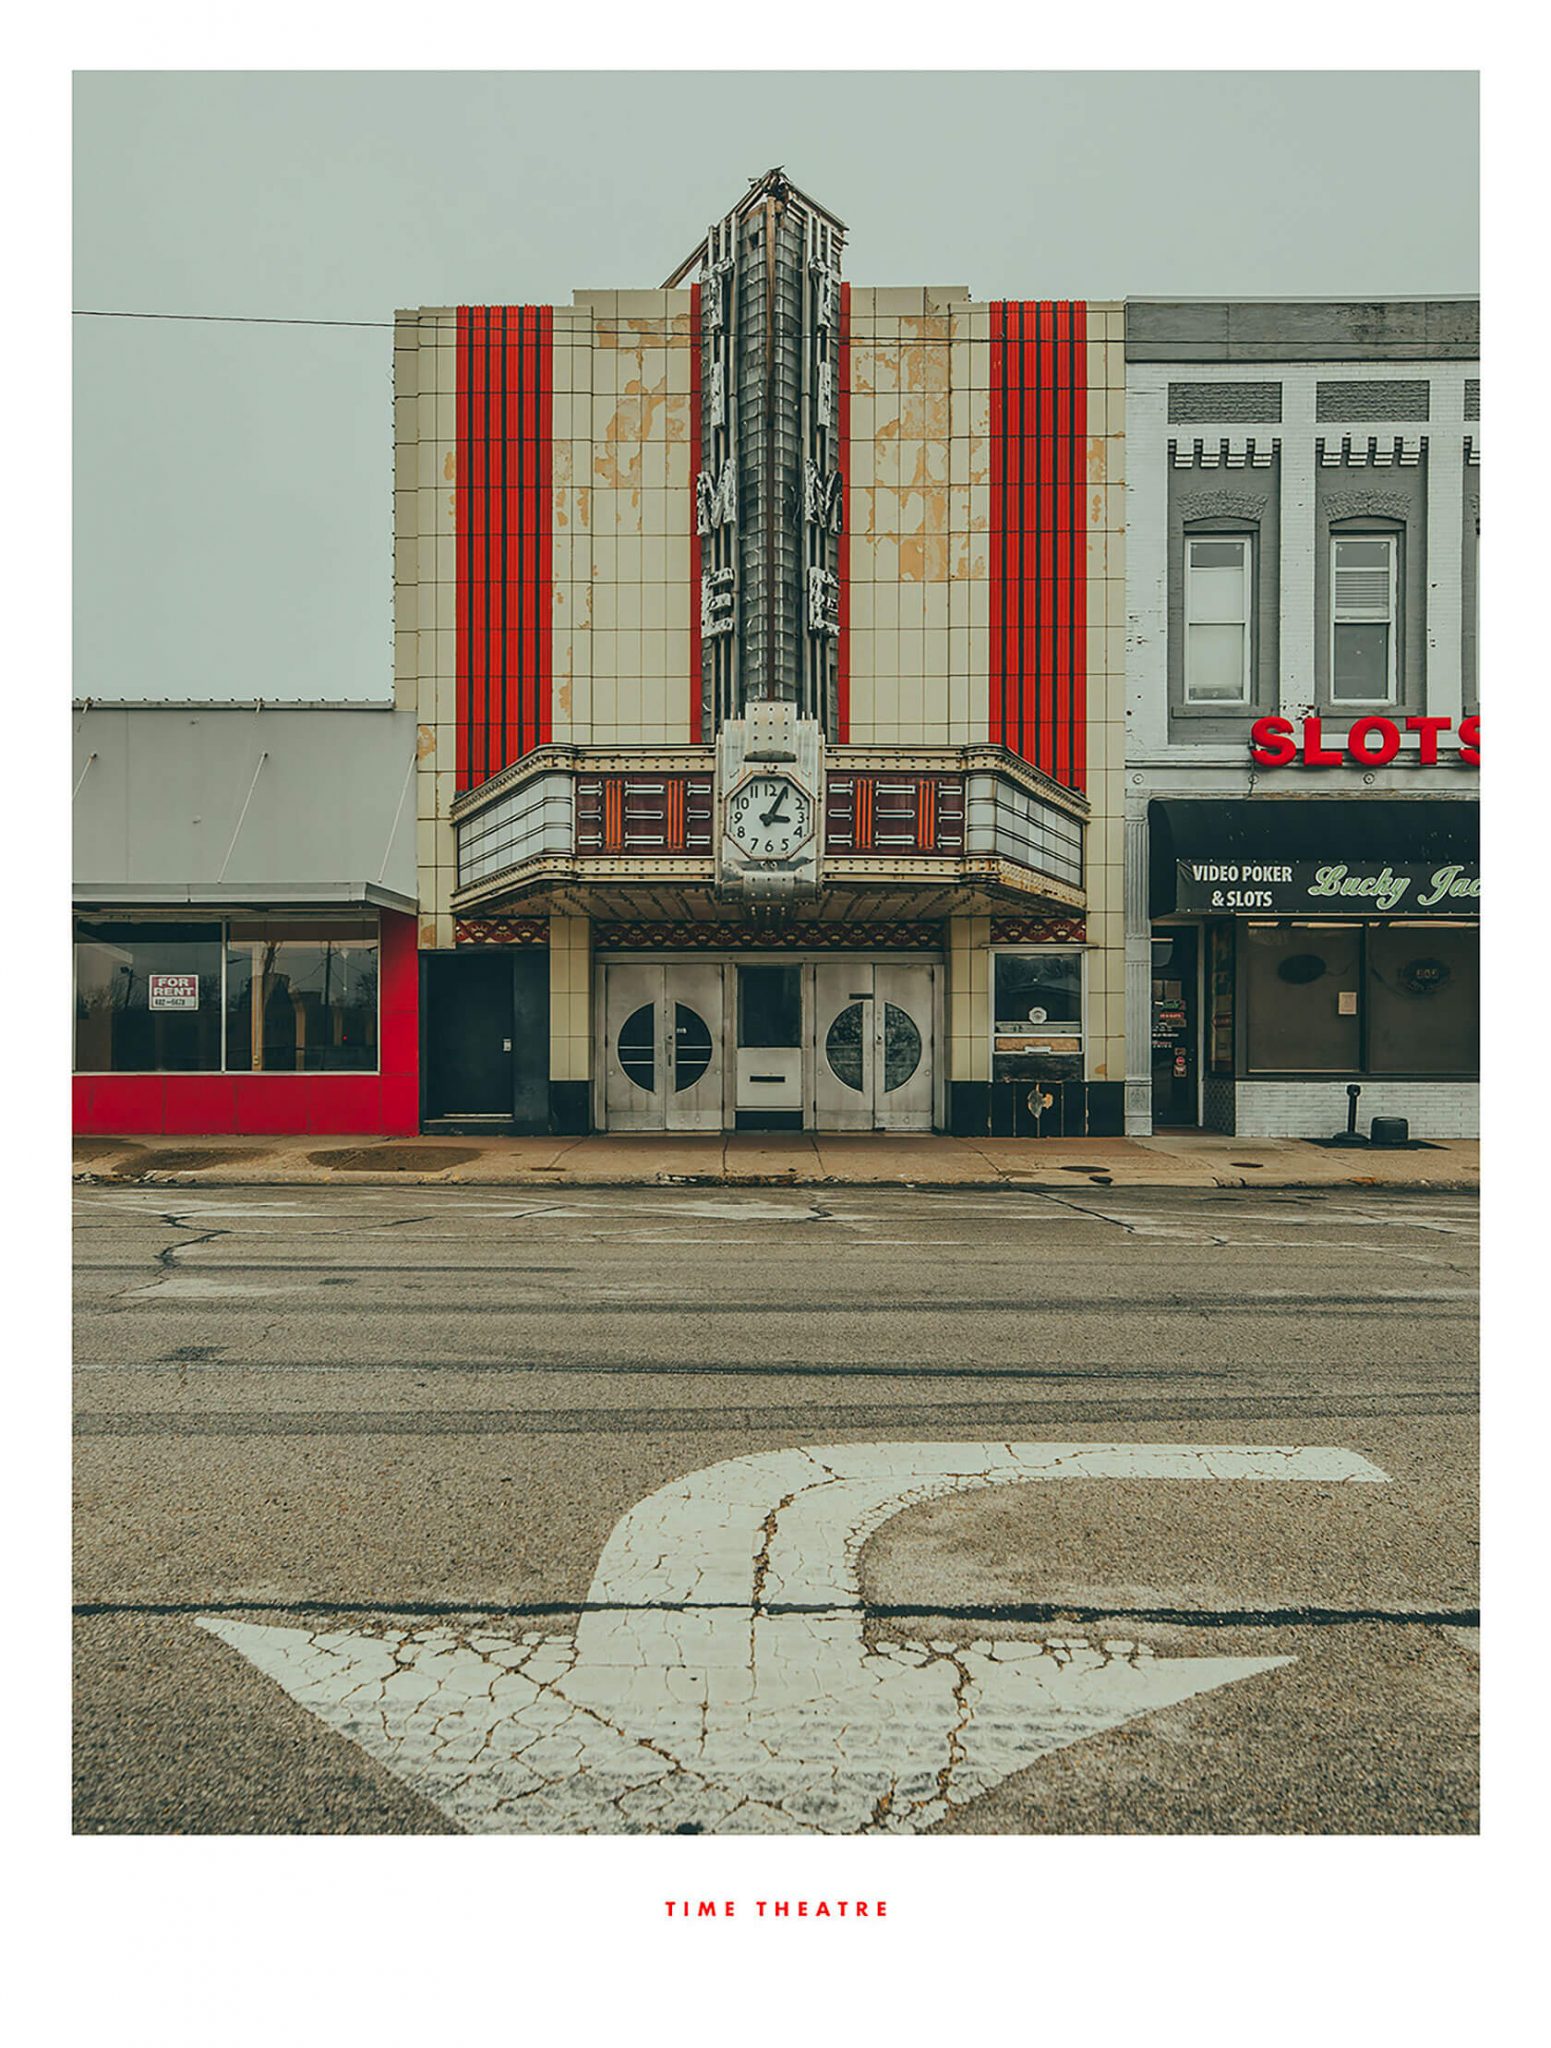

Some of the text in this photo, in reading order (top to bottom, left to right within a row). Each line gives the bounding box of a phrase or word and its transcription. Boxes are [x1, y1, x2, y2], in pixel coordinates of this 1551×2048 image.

[749, 785, 759, 799] 11
[764, 784, 778, 797] 12
[736, 797, 750, 810] 10
[795, 798, 805, 810] 2
[734, 812, 743, 824] 9
[798, 811, 805, 824] 3
[737, 826, 746, 839] 8
[793, 826, 803, 838] 4
[750, 838, 759, 851] 7
[765, 840, 774, 853] 6
[781, 838, 789, 851] 5
[1192, 864, 1293, 883] VIDEO POKER
[1307, 864, 1411, 910] Lucky
[1211, 890, 1273, 907] & SLOTS
[158, 978, 189, 987] FOR
[153, 987, 195, 996] RENT
